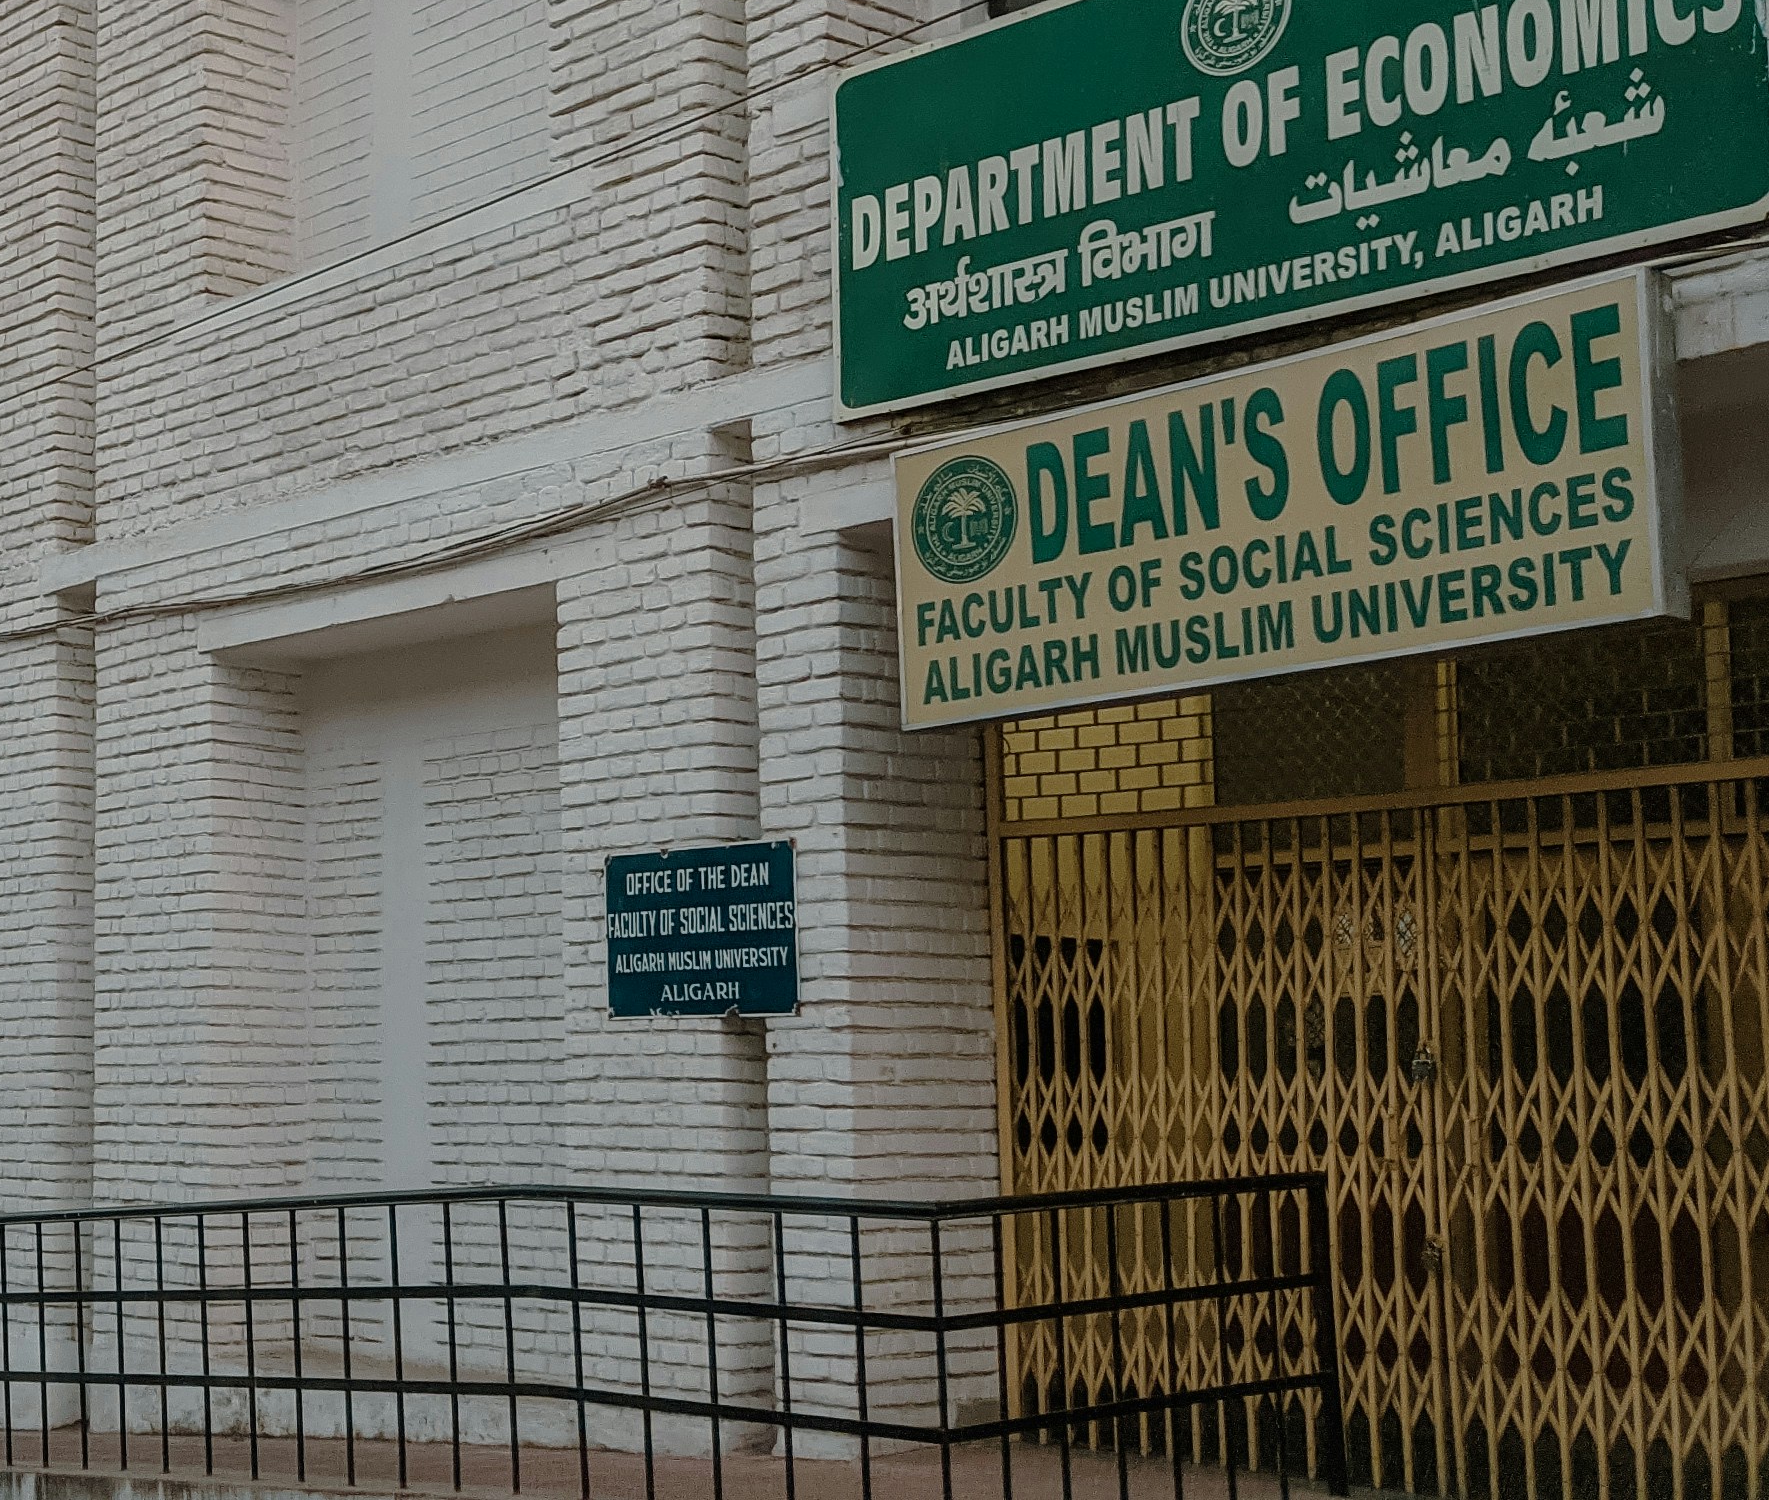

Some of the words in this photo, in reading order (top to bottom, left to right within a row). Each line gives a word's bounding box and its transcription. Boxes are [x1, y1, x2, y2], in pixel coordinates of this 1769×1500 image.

[851, 95, 1201, 271] DEPARTMENT
[1222, 65, 1300, 168] OF
[903, 248, 1069, 331] अर्थशास्त्र
[1078, 210, 1216, 288] विभाग
[945, 314, 1070, 371] ALIGARH
[1078, 283, 1199, 339] MUSLIM
[1208, 230, 1426, 309] UNIVERSITY,
[1435, 184, 1604, 258] ALIGARH
[1025, 386, 1291, 565] DEAN'S
[1316, 303, 1630, 506] OFFICE
[916, 570, 1093, 647] FACULTY
[1107, 557, 1162, 614] OF
[1178, 525, 1352, 601] SOCIAL
[1368, 466, 1636, 566] SCIENCES
[922, 633, 1100, 705] ALIGARH
[1115, 601, 1296, 677] MUSLIM
[1312, 538, 1633, 645] UNIVERSITY
[607, 909, 657, 939] FACULTY
[660, 908, 675, 935] OF
[680, 906, 725, 935] SOCIAL
[728, 901, 795, 932] SCIENCES
[626, 870, 672, 896] OFFICE
[676, 868, 694, 892] OF
[698, 865, 726, 890] THE
[731, 861, 770, 888] DEAN
[615, 953, 664, 974] ALIGARH
[668, 950, 711, 971] MUSLIM
[715, 946, 789, 969] UNIVERSITY
[660, 981, 740, 1002] ALIGARH
